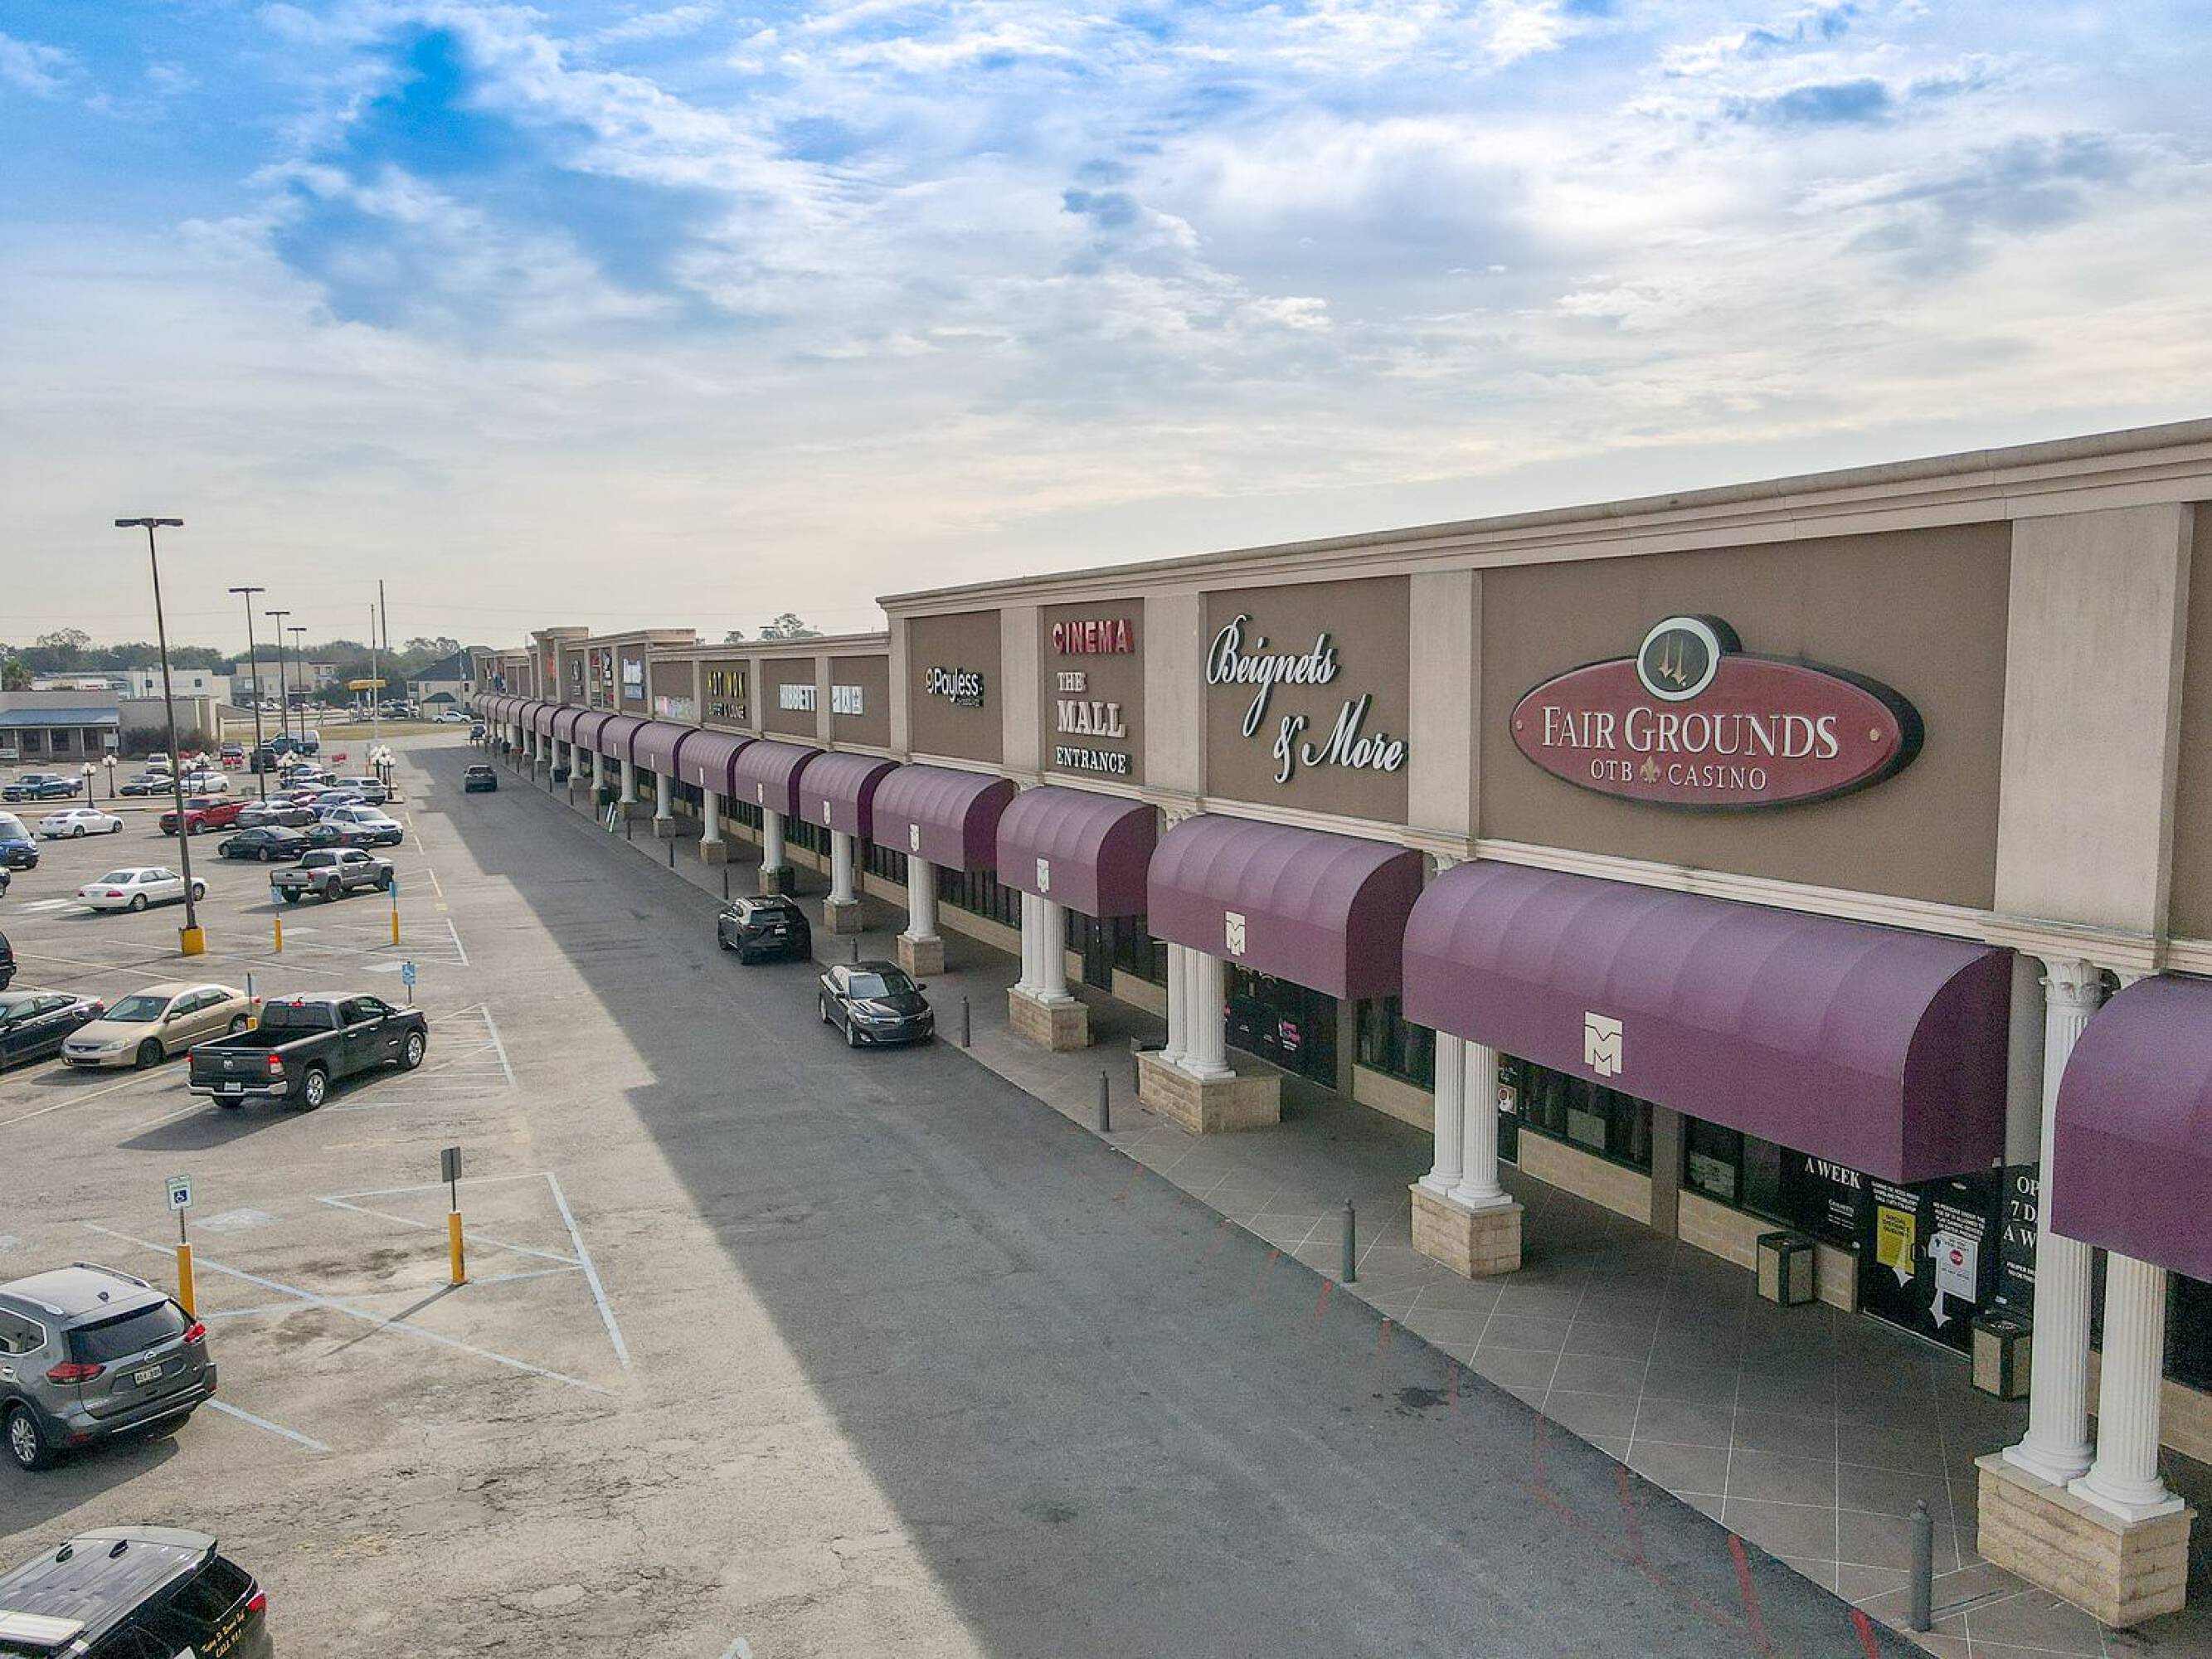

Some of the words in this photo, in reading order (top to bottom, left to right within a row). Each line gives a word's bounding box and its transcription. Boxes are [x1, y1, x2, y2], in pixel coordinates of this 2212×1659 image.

[1052, 619, 1131, 654] CINEMA
[933, 667, 980, 703] Payless
[1057, 672, 1086, 692] THE
[1206, 614, 1337, 737] Beignets
[1057, 699, 1126, 738] MALL
[1541, 705, 1616, 750] FAIR
[1624, 706, 1839, 760] GROUNDS
[1273, 716, 1305, 783] &
[1301, 693, 1403, 771] More
[1056, 746, 1127, 775] ENTRANCE
[1590, 758, 1633, 781] OTB
[1668, 762, 1767, 791] CASINO
[1804, 1157, 1815, 1174] A
[1817, 1160, 1861, 1190] WEEK
[2010, 1199, 2020, 1217] 7
[2024, 1203, 2038, 1224] D
[2002, 1224, 2015, 1243] A
